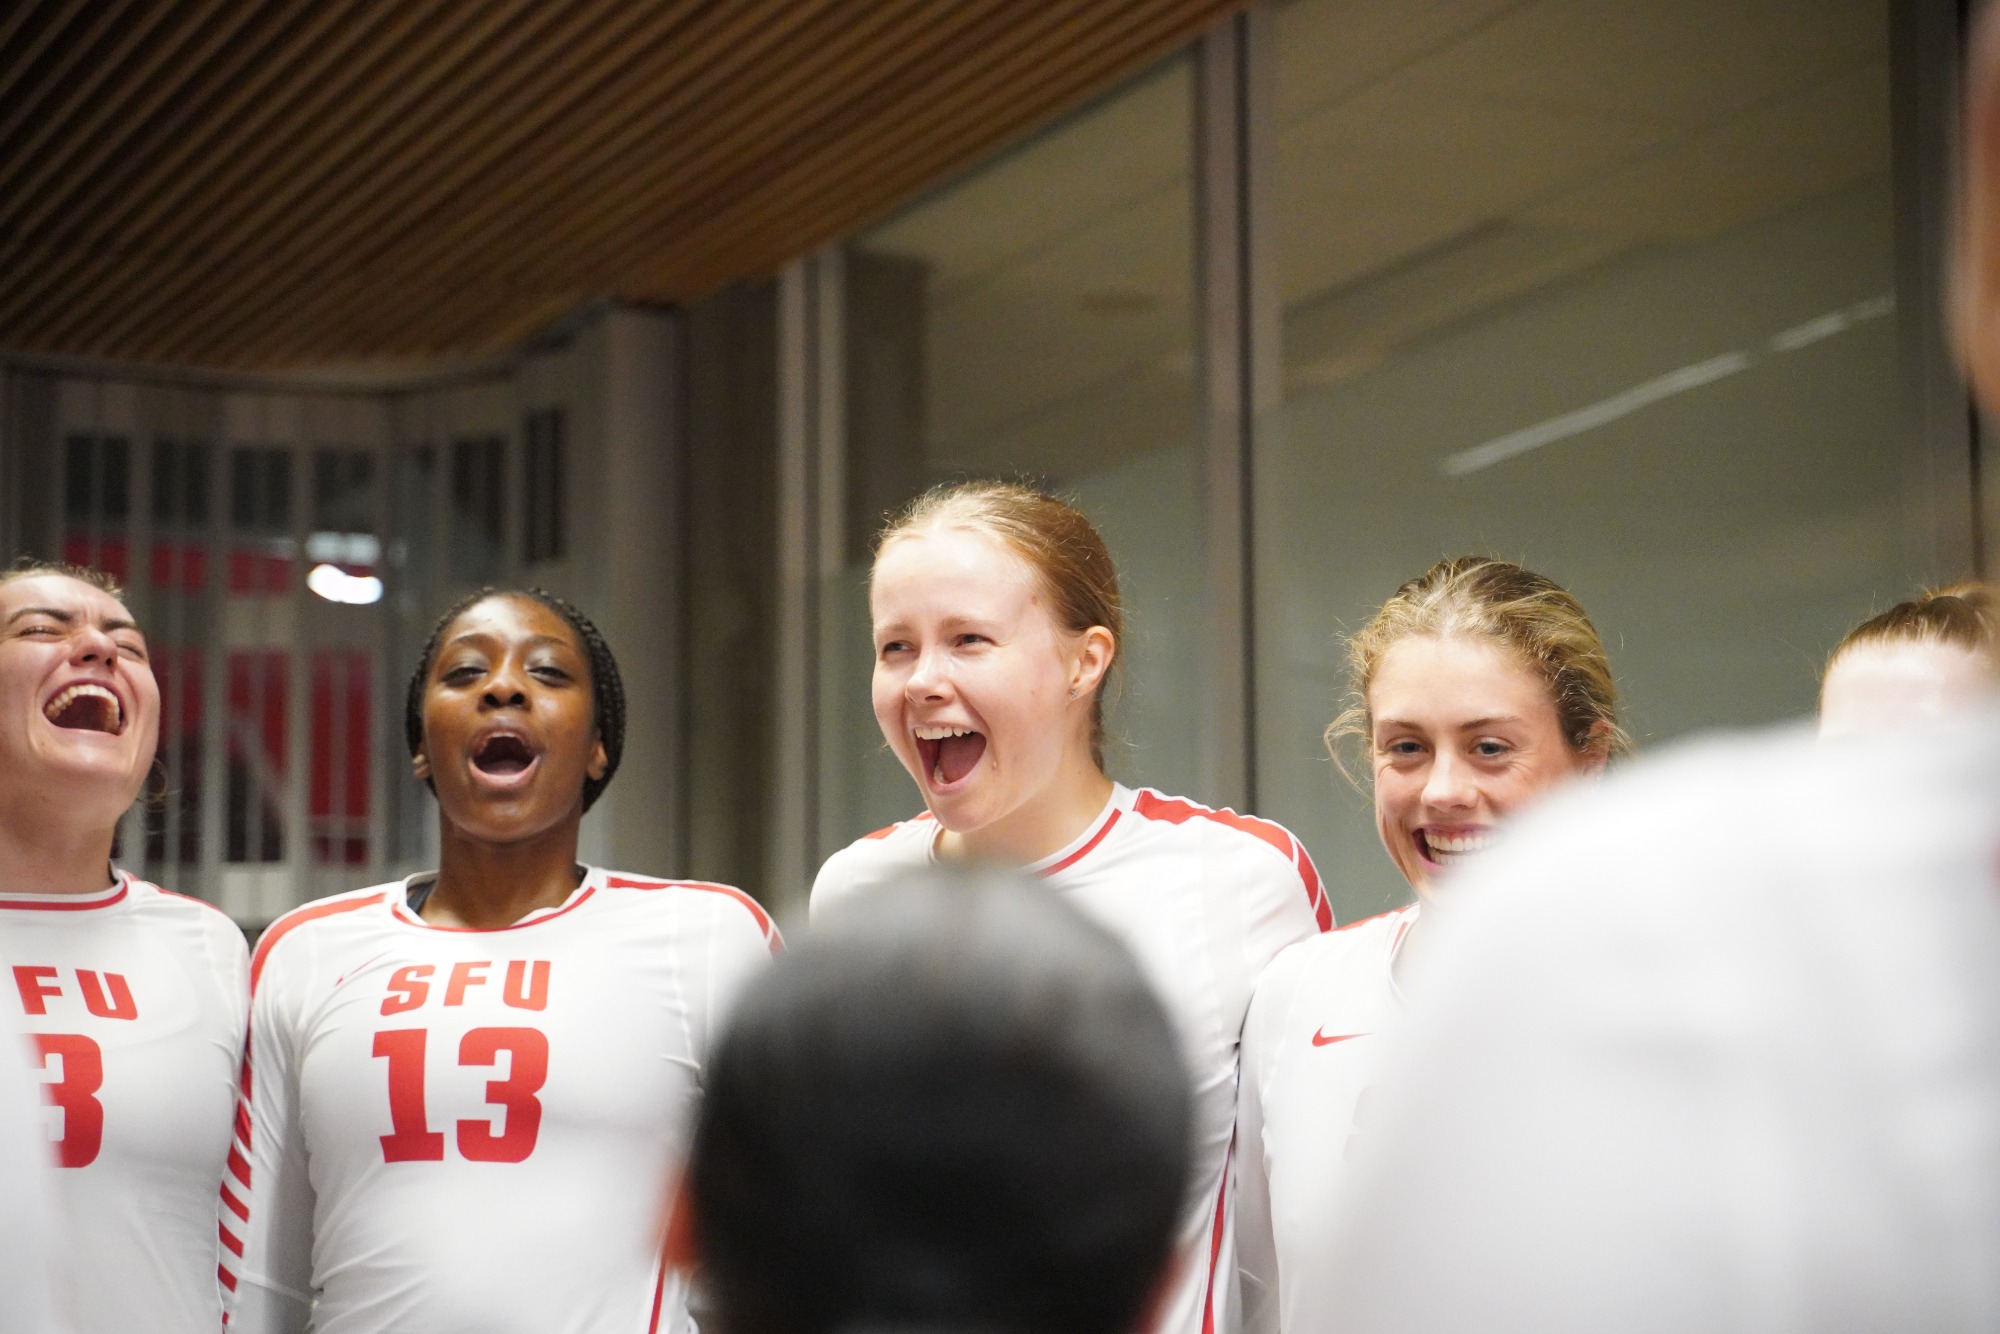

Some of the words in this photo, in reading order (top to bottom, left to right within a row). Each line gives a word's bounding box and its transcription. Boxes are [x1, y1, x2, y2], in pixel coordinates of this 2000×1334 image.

[12, 965, 138, 1020] FU
[380, 960, 550, 1016] SFU
[371, 1026, 550, 1163] 13
